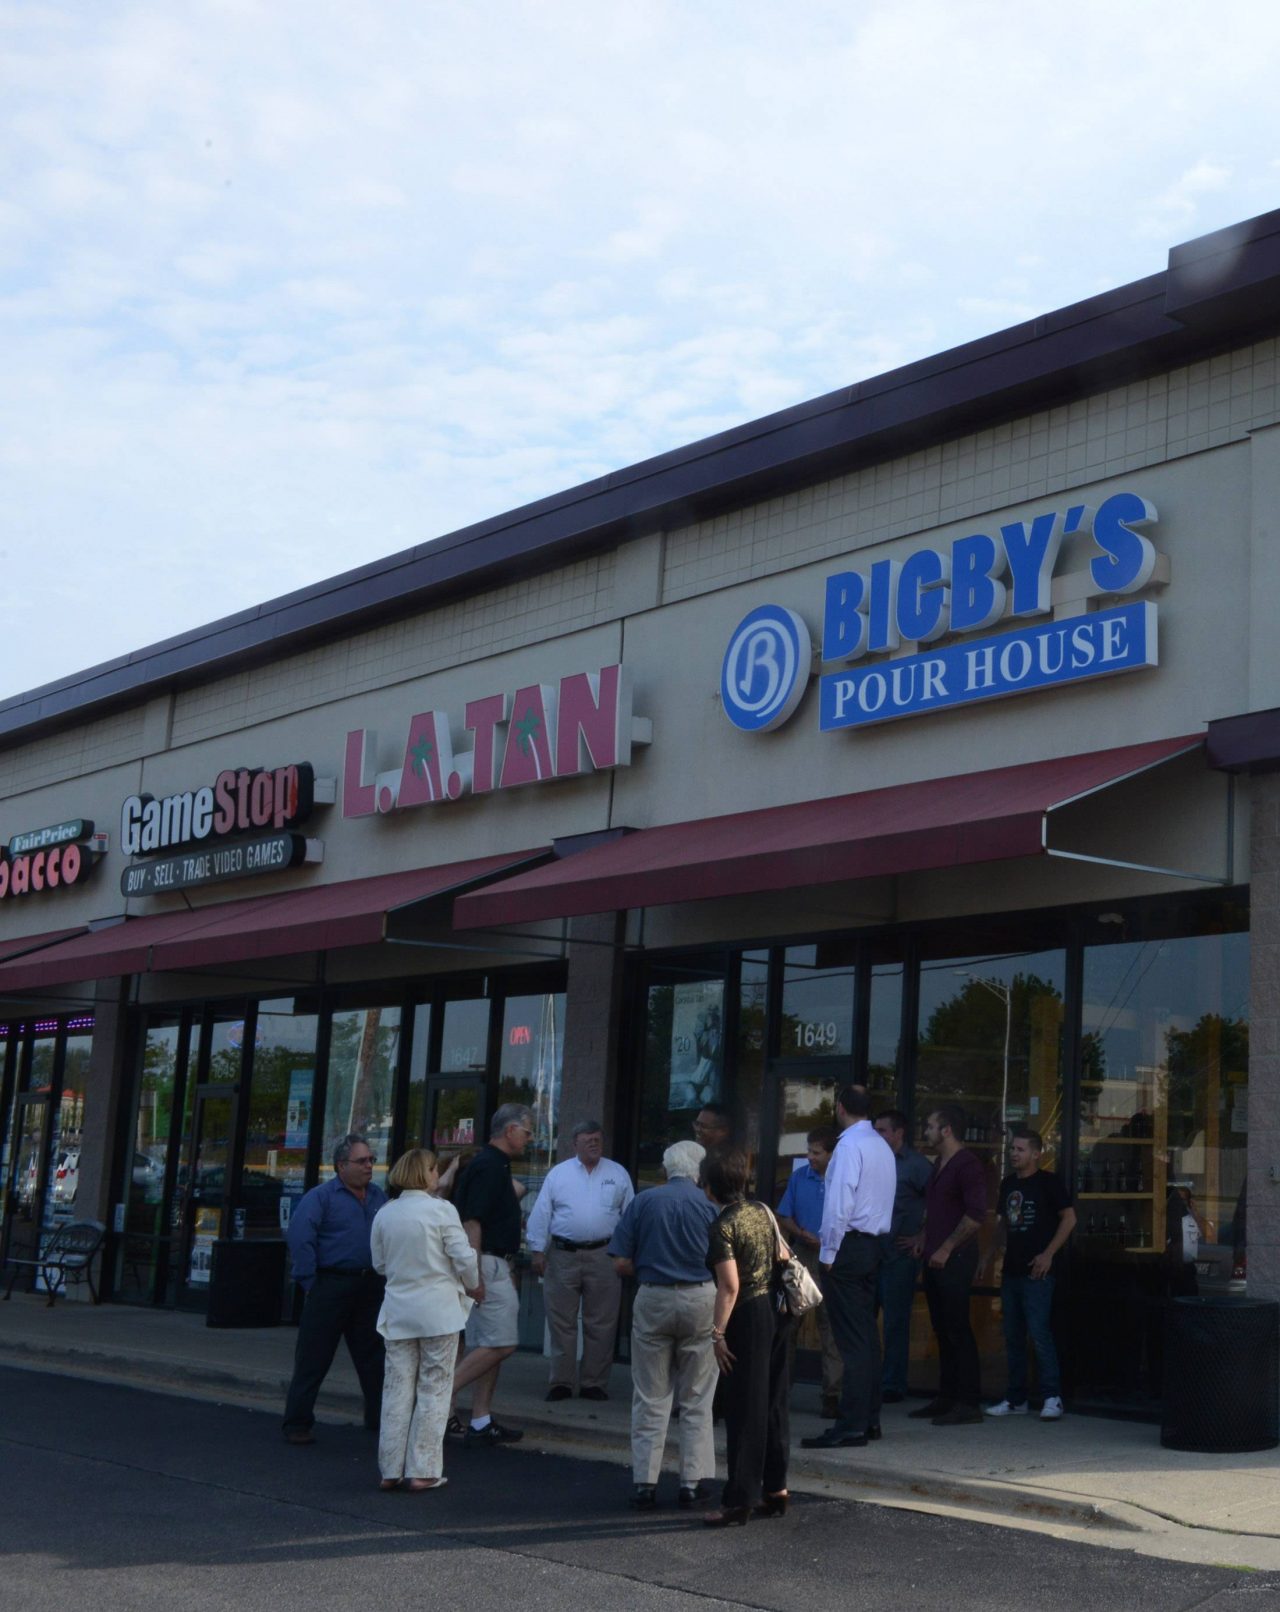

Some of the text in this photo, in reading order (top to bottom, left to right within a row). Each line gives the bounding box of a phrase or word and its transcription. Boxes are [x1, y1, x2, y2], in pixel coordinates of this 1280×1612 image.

[822, 492, 1148, 662] BIGBY'S
[833, 616, 1129, 719] POUR HOUSE
[120, 764, 299, 856] GameStop
[128, 839, 284, 892] BUY SELL TRADE VIDEO GAMES
[509, 1026, 531, 1045] OPEN
[794, 1022, 837, 1048] 1649
